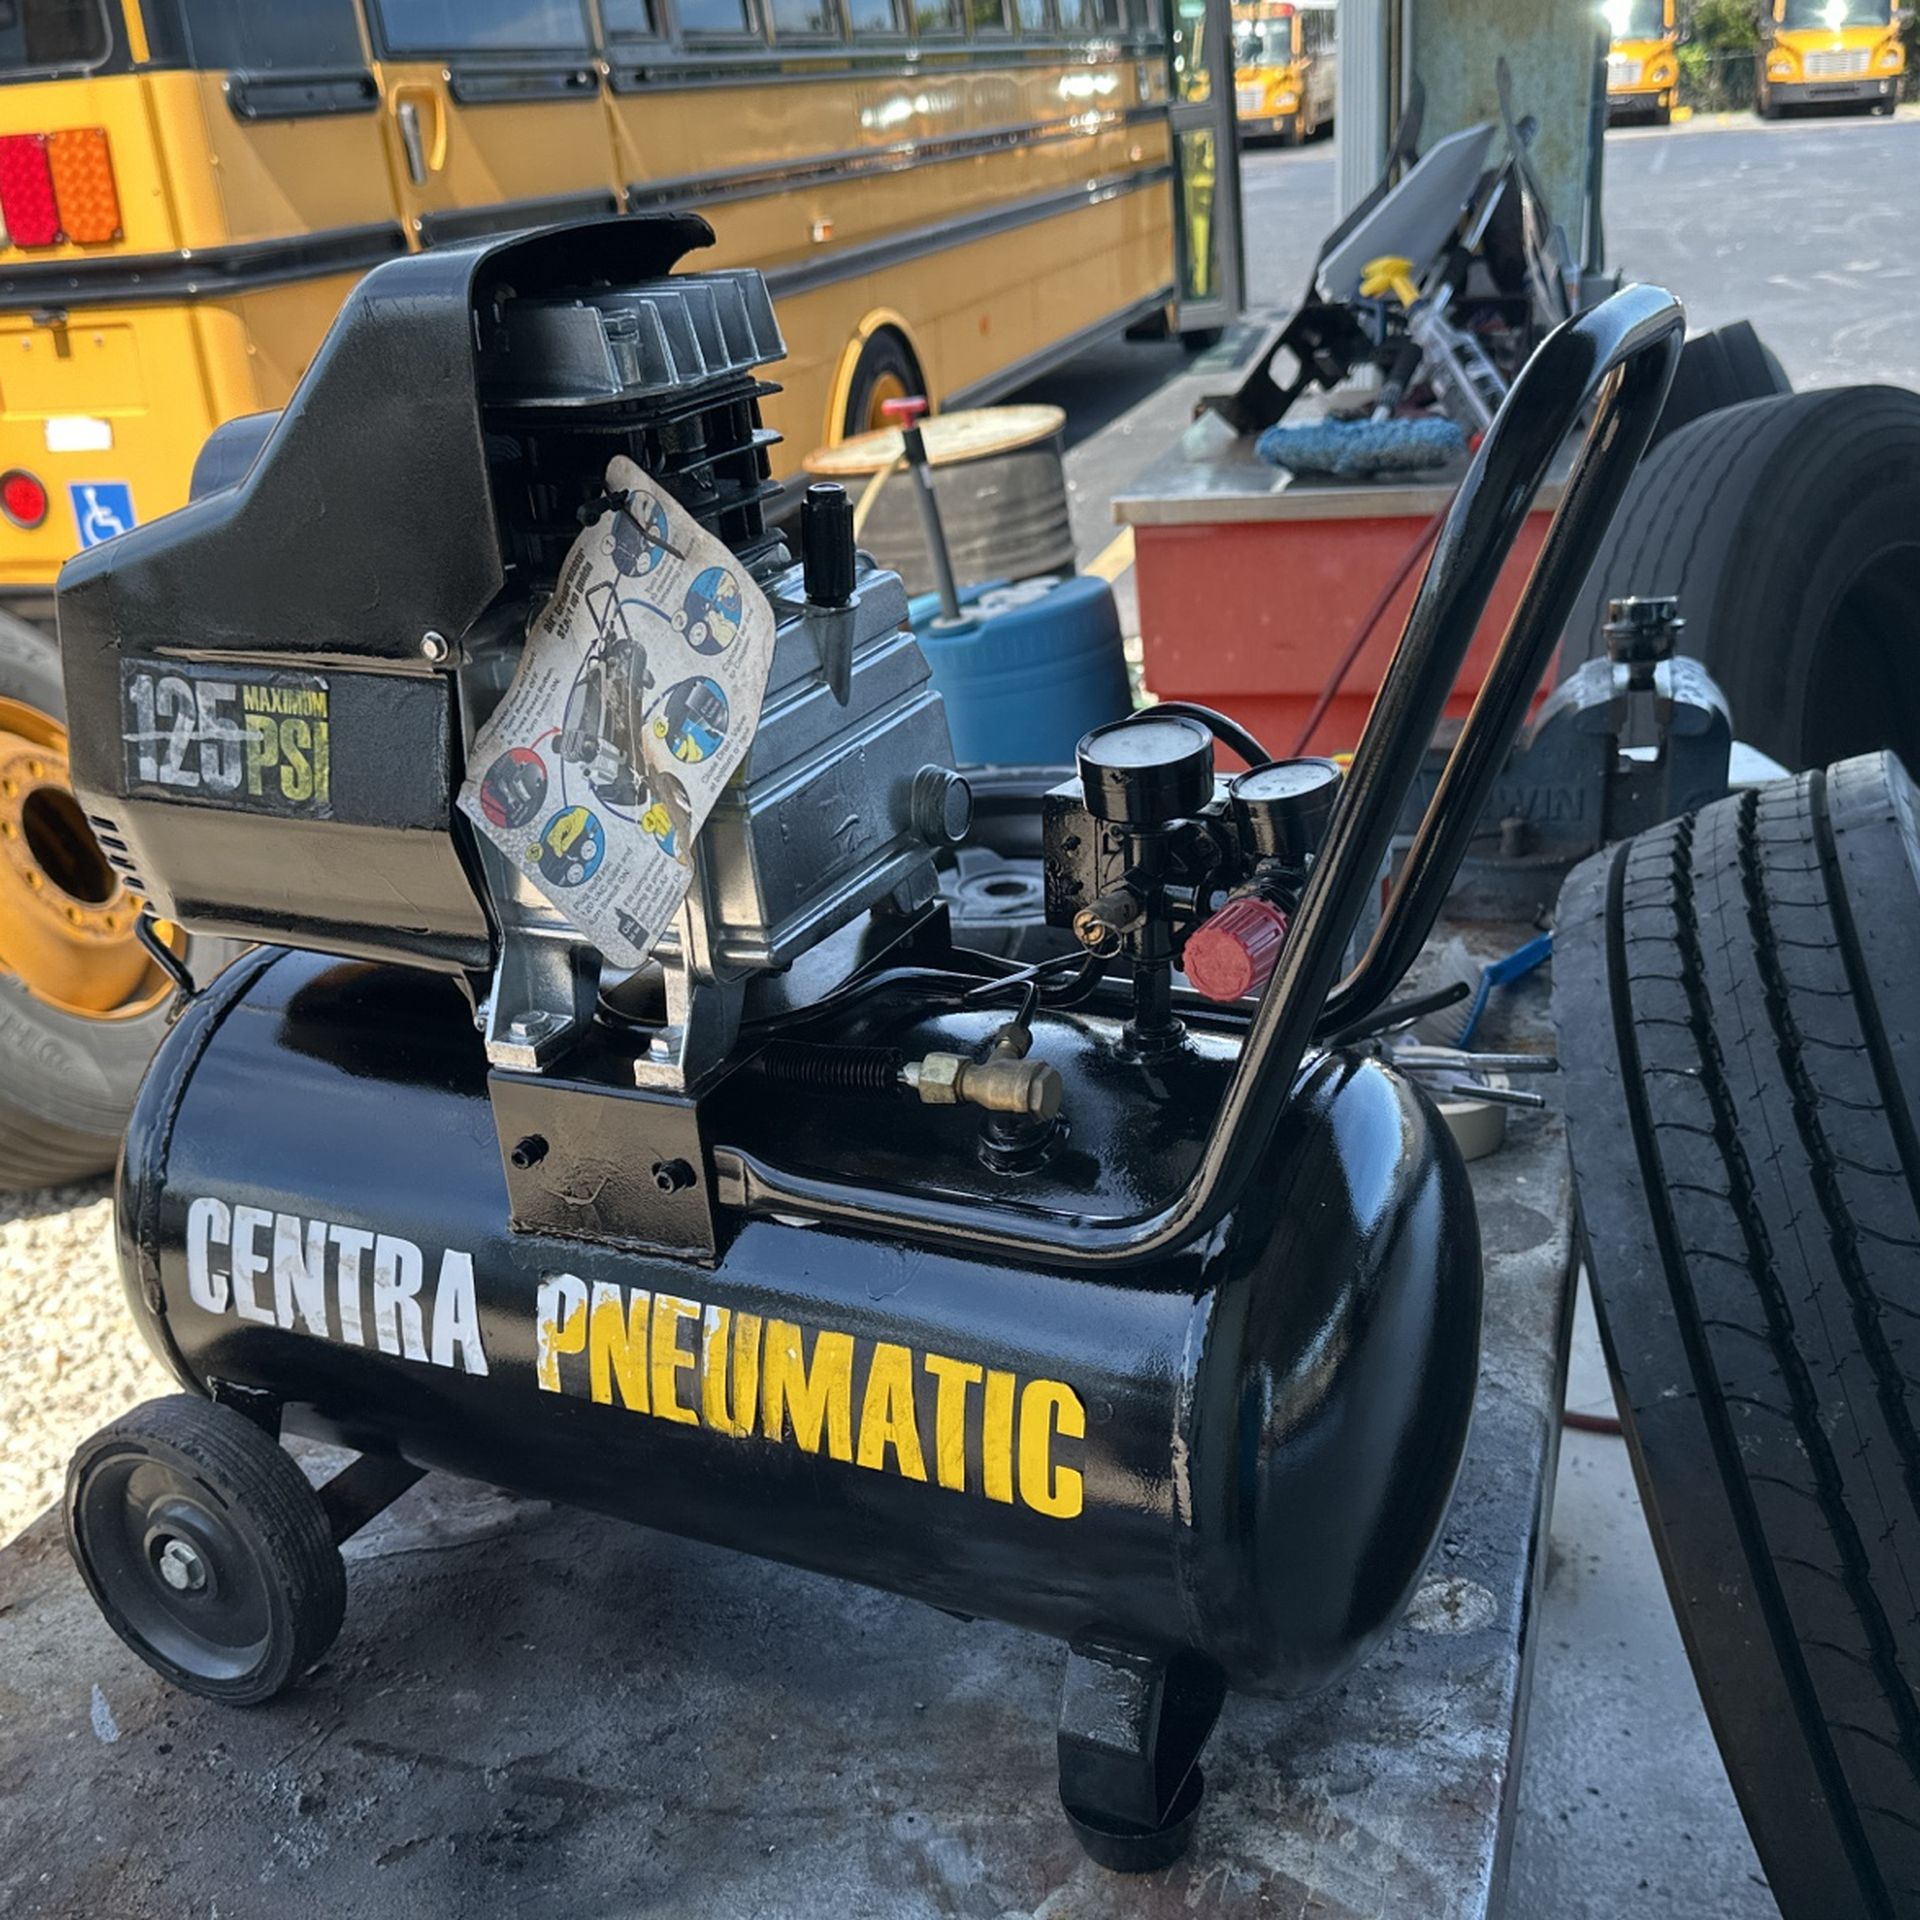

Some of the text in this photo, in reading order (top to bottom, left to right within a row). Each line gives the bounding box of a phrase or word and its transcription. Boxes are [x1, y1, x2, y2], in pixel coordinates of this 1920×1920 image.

[543, 613, 557, 633] air
[129, 674, 328, 790] 125 MAXIMUM
[244, 714, 329, 804] PSI
[187, 1197, 1086, 1520] CENTRA PNEUMATIC
